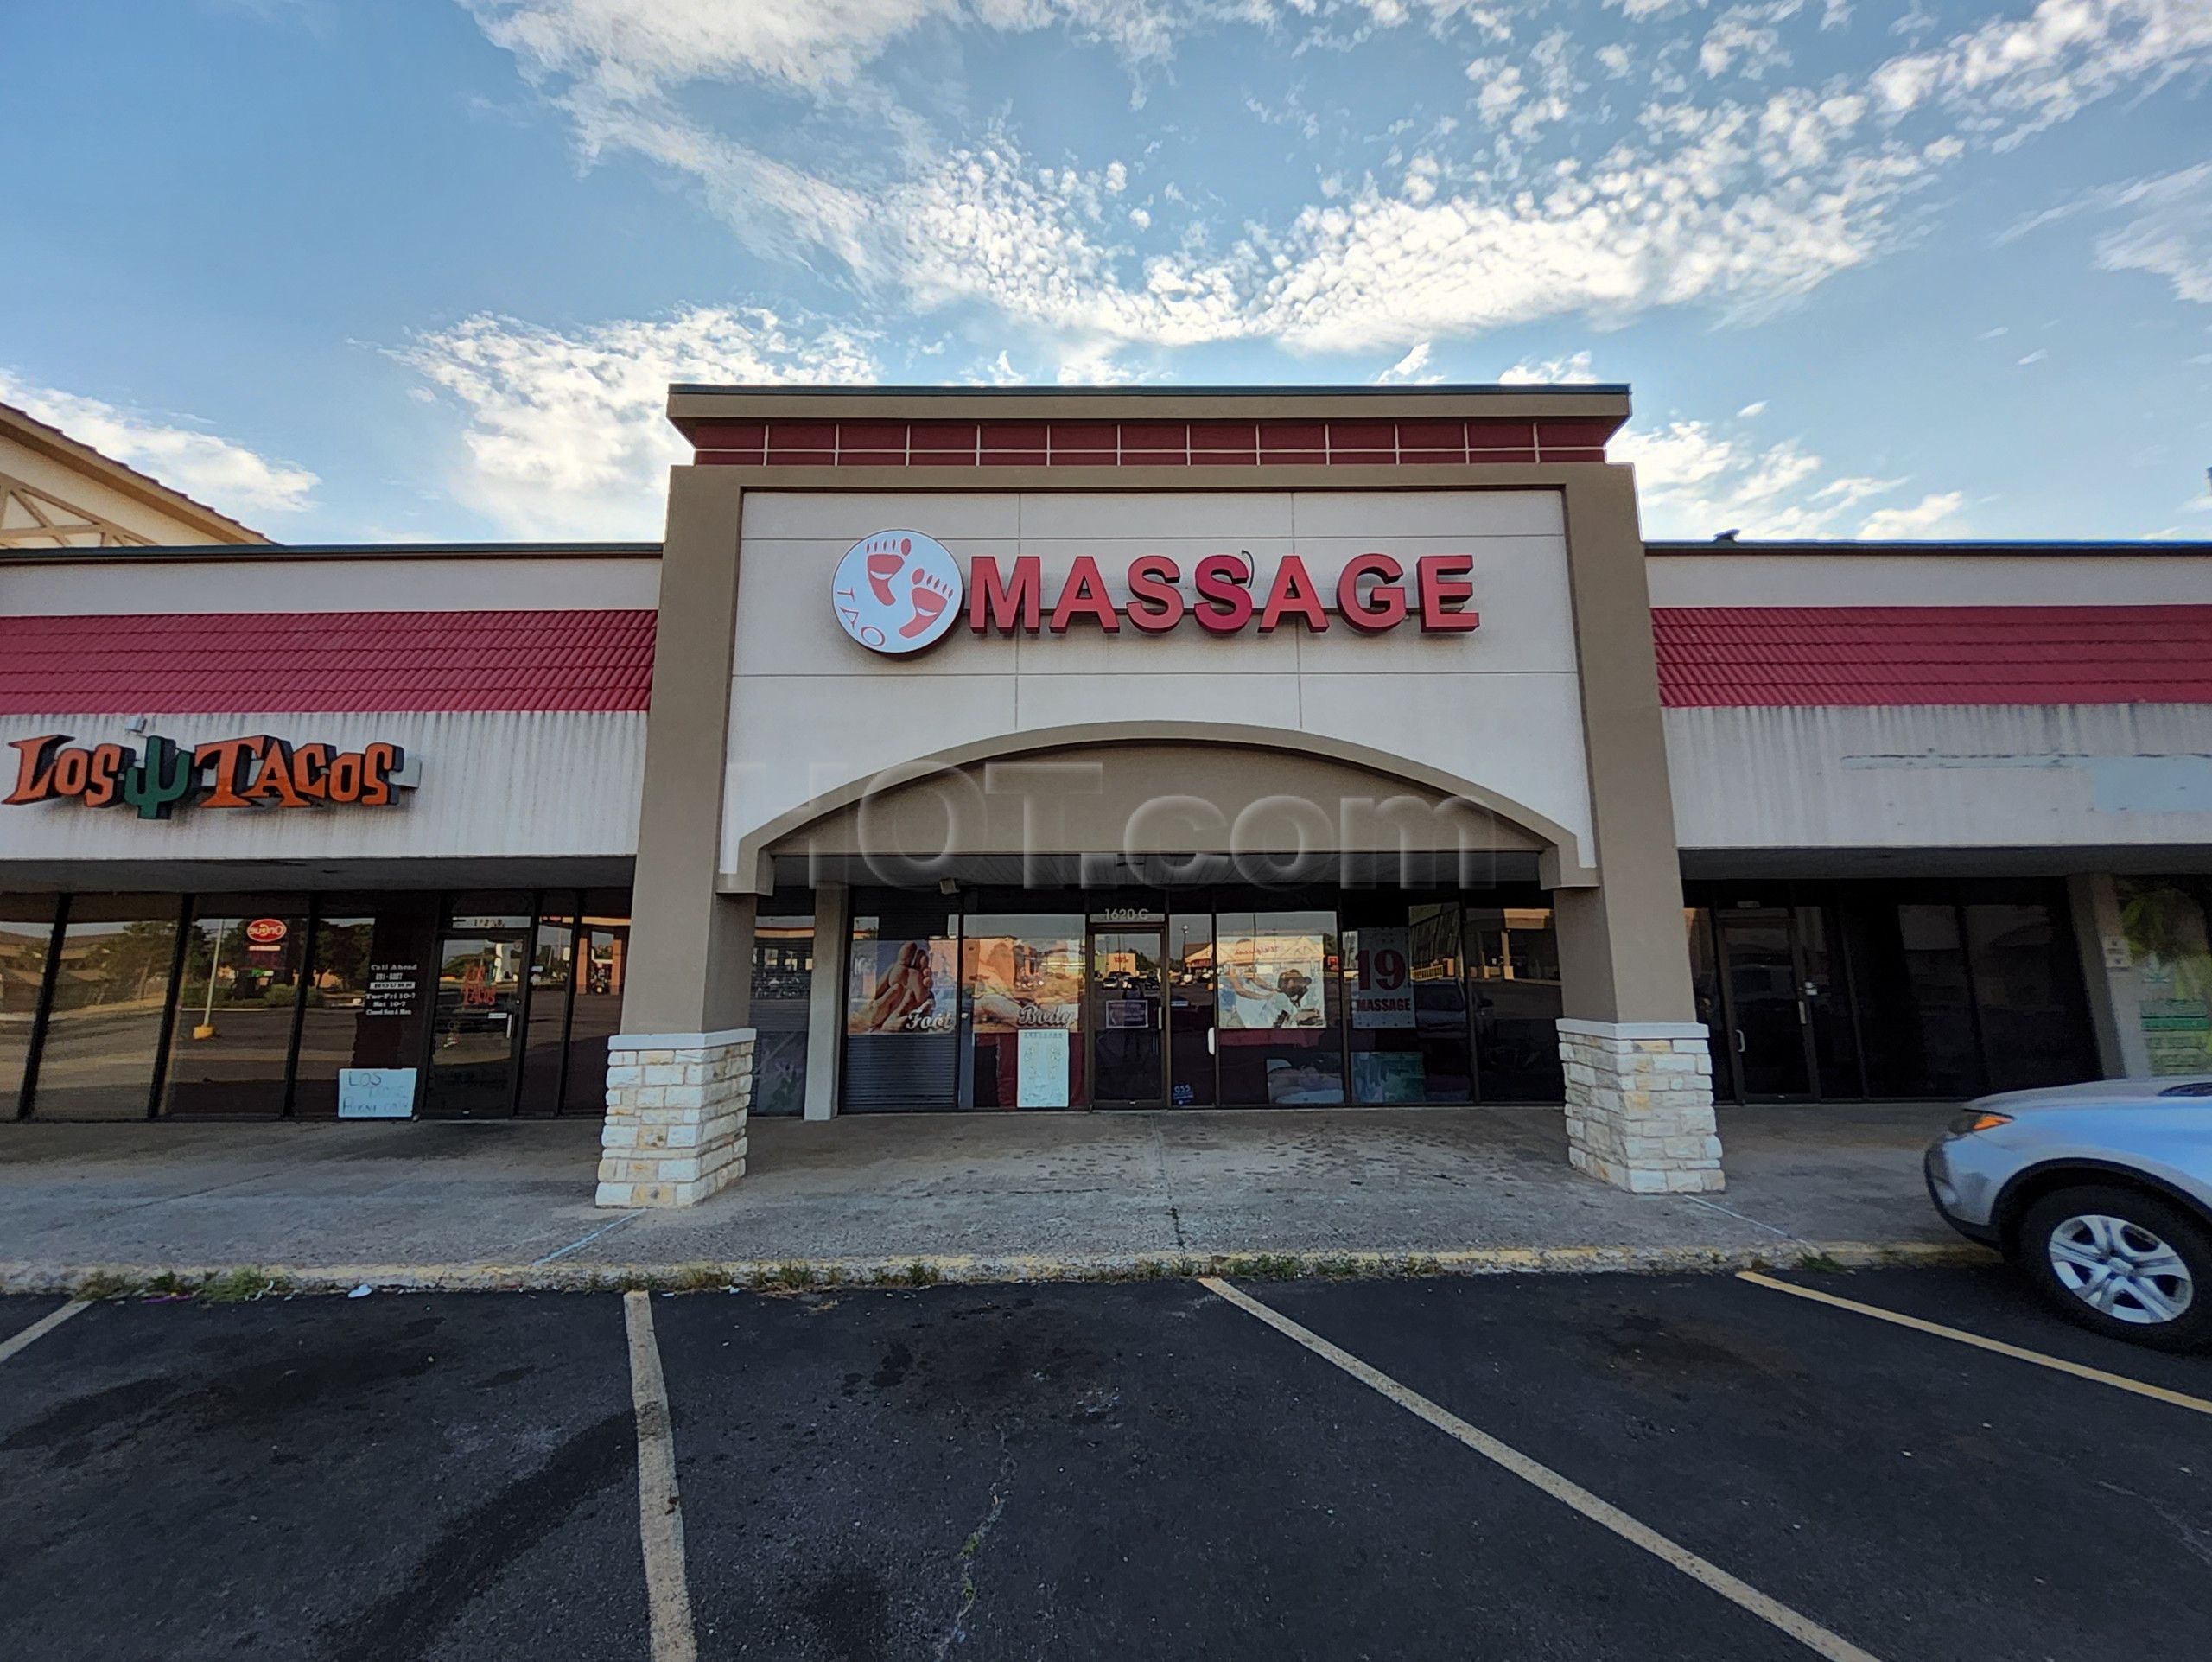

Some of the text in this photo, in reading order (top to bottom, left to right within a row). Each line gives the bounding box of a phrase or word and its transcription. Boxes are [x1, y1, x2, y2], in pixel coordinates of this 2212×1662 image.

[970, 553, 1480, 634] MASSAGE
[836, 583, 886, 646] TAO
[2, 734, 401, 808] LOS TACOS
[1104, 908, 1135, 920] 1620
[1355, 949, 1406, 990] 19
[905, 1009, 954, 1030] Foot
[1017, 1004, 1074, 1028] Body
[1357, 998, 1411, 1011] MASSAGE
